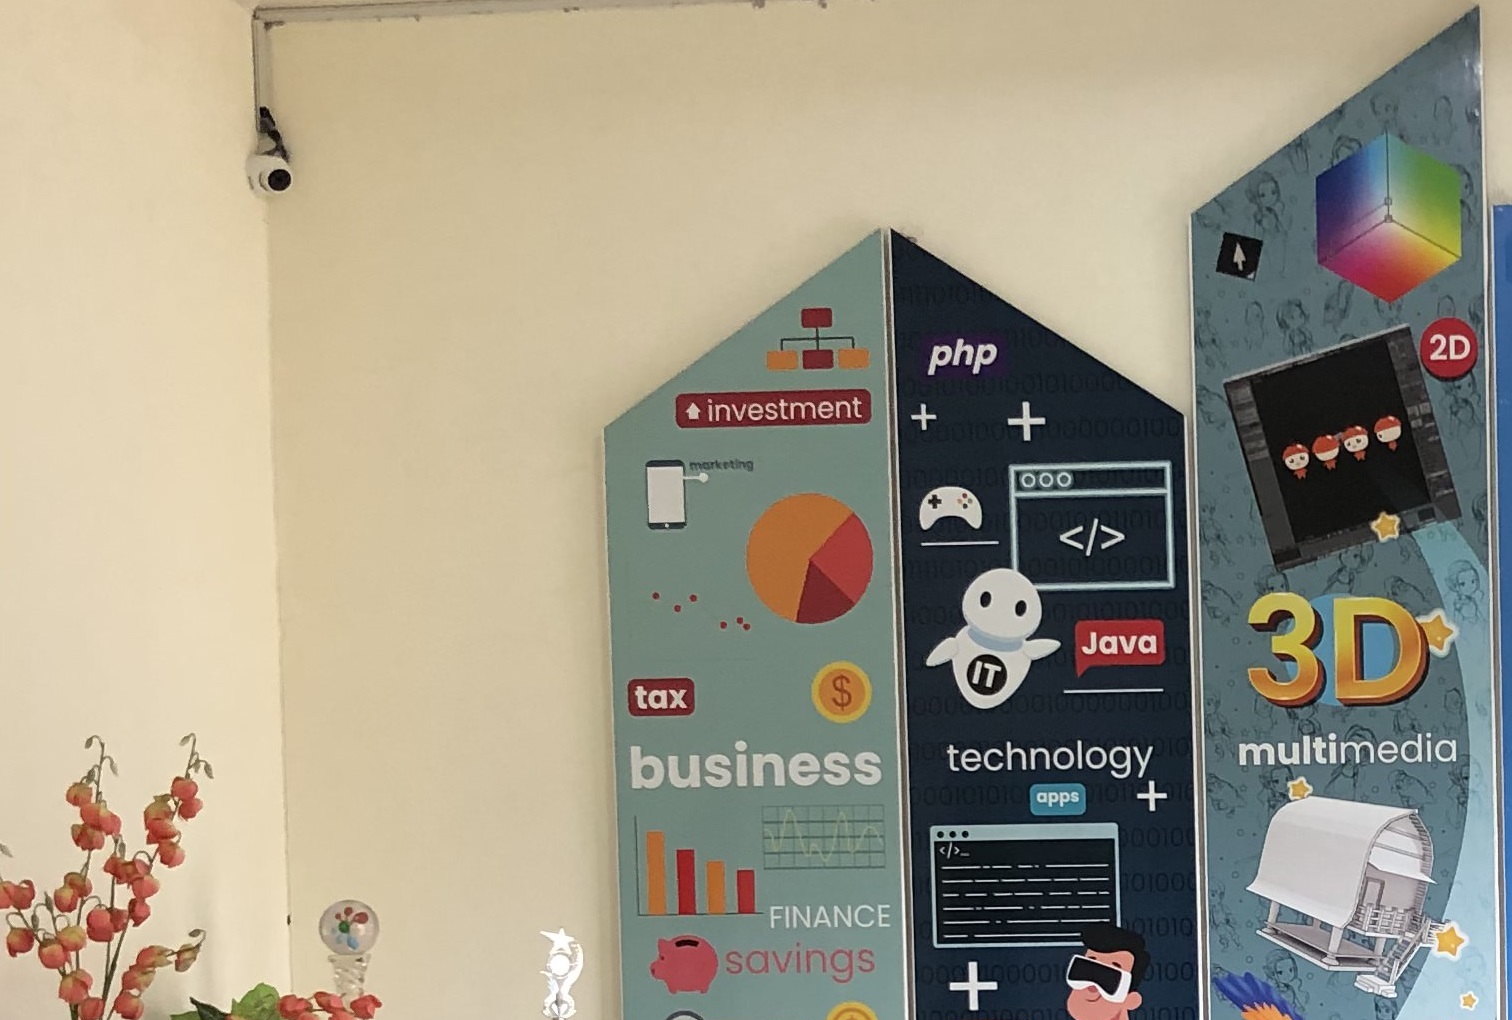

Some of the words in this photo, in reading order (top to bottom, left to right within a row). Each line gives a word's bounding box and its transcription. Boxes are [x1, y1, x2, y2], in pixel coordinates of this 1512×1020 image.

[927, 338, 998, 375] php
[1430, 334, 1472, 362] 2D
[707, 396, 863, 423] investment
[688, 456, 754, 472] marketing
[1081, 631, 1158, 656] Java
[1247, 592, 1430, 707] 3D
[972, 661, 1002, 689] IT
[634, 685, 688, 711] tax
[946, 740, 1155, 778] technology
[1238, 732, 1458, 767] multimedia
[630, 740, 883, 791] business
[1036, 789, 1081, 808] apps
[770, 903, 892, 929] FINANCE
[725, 942, 876, 984] savings
